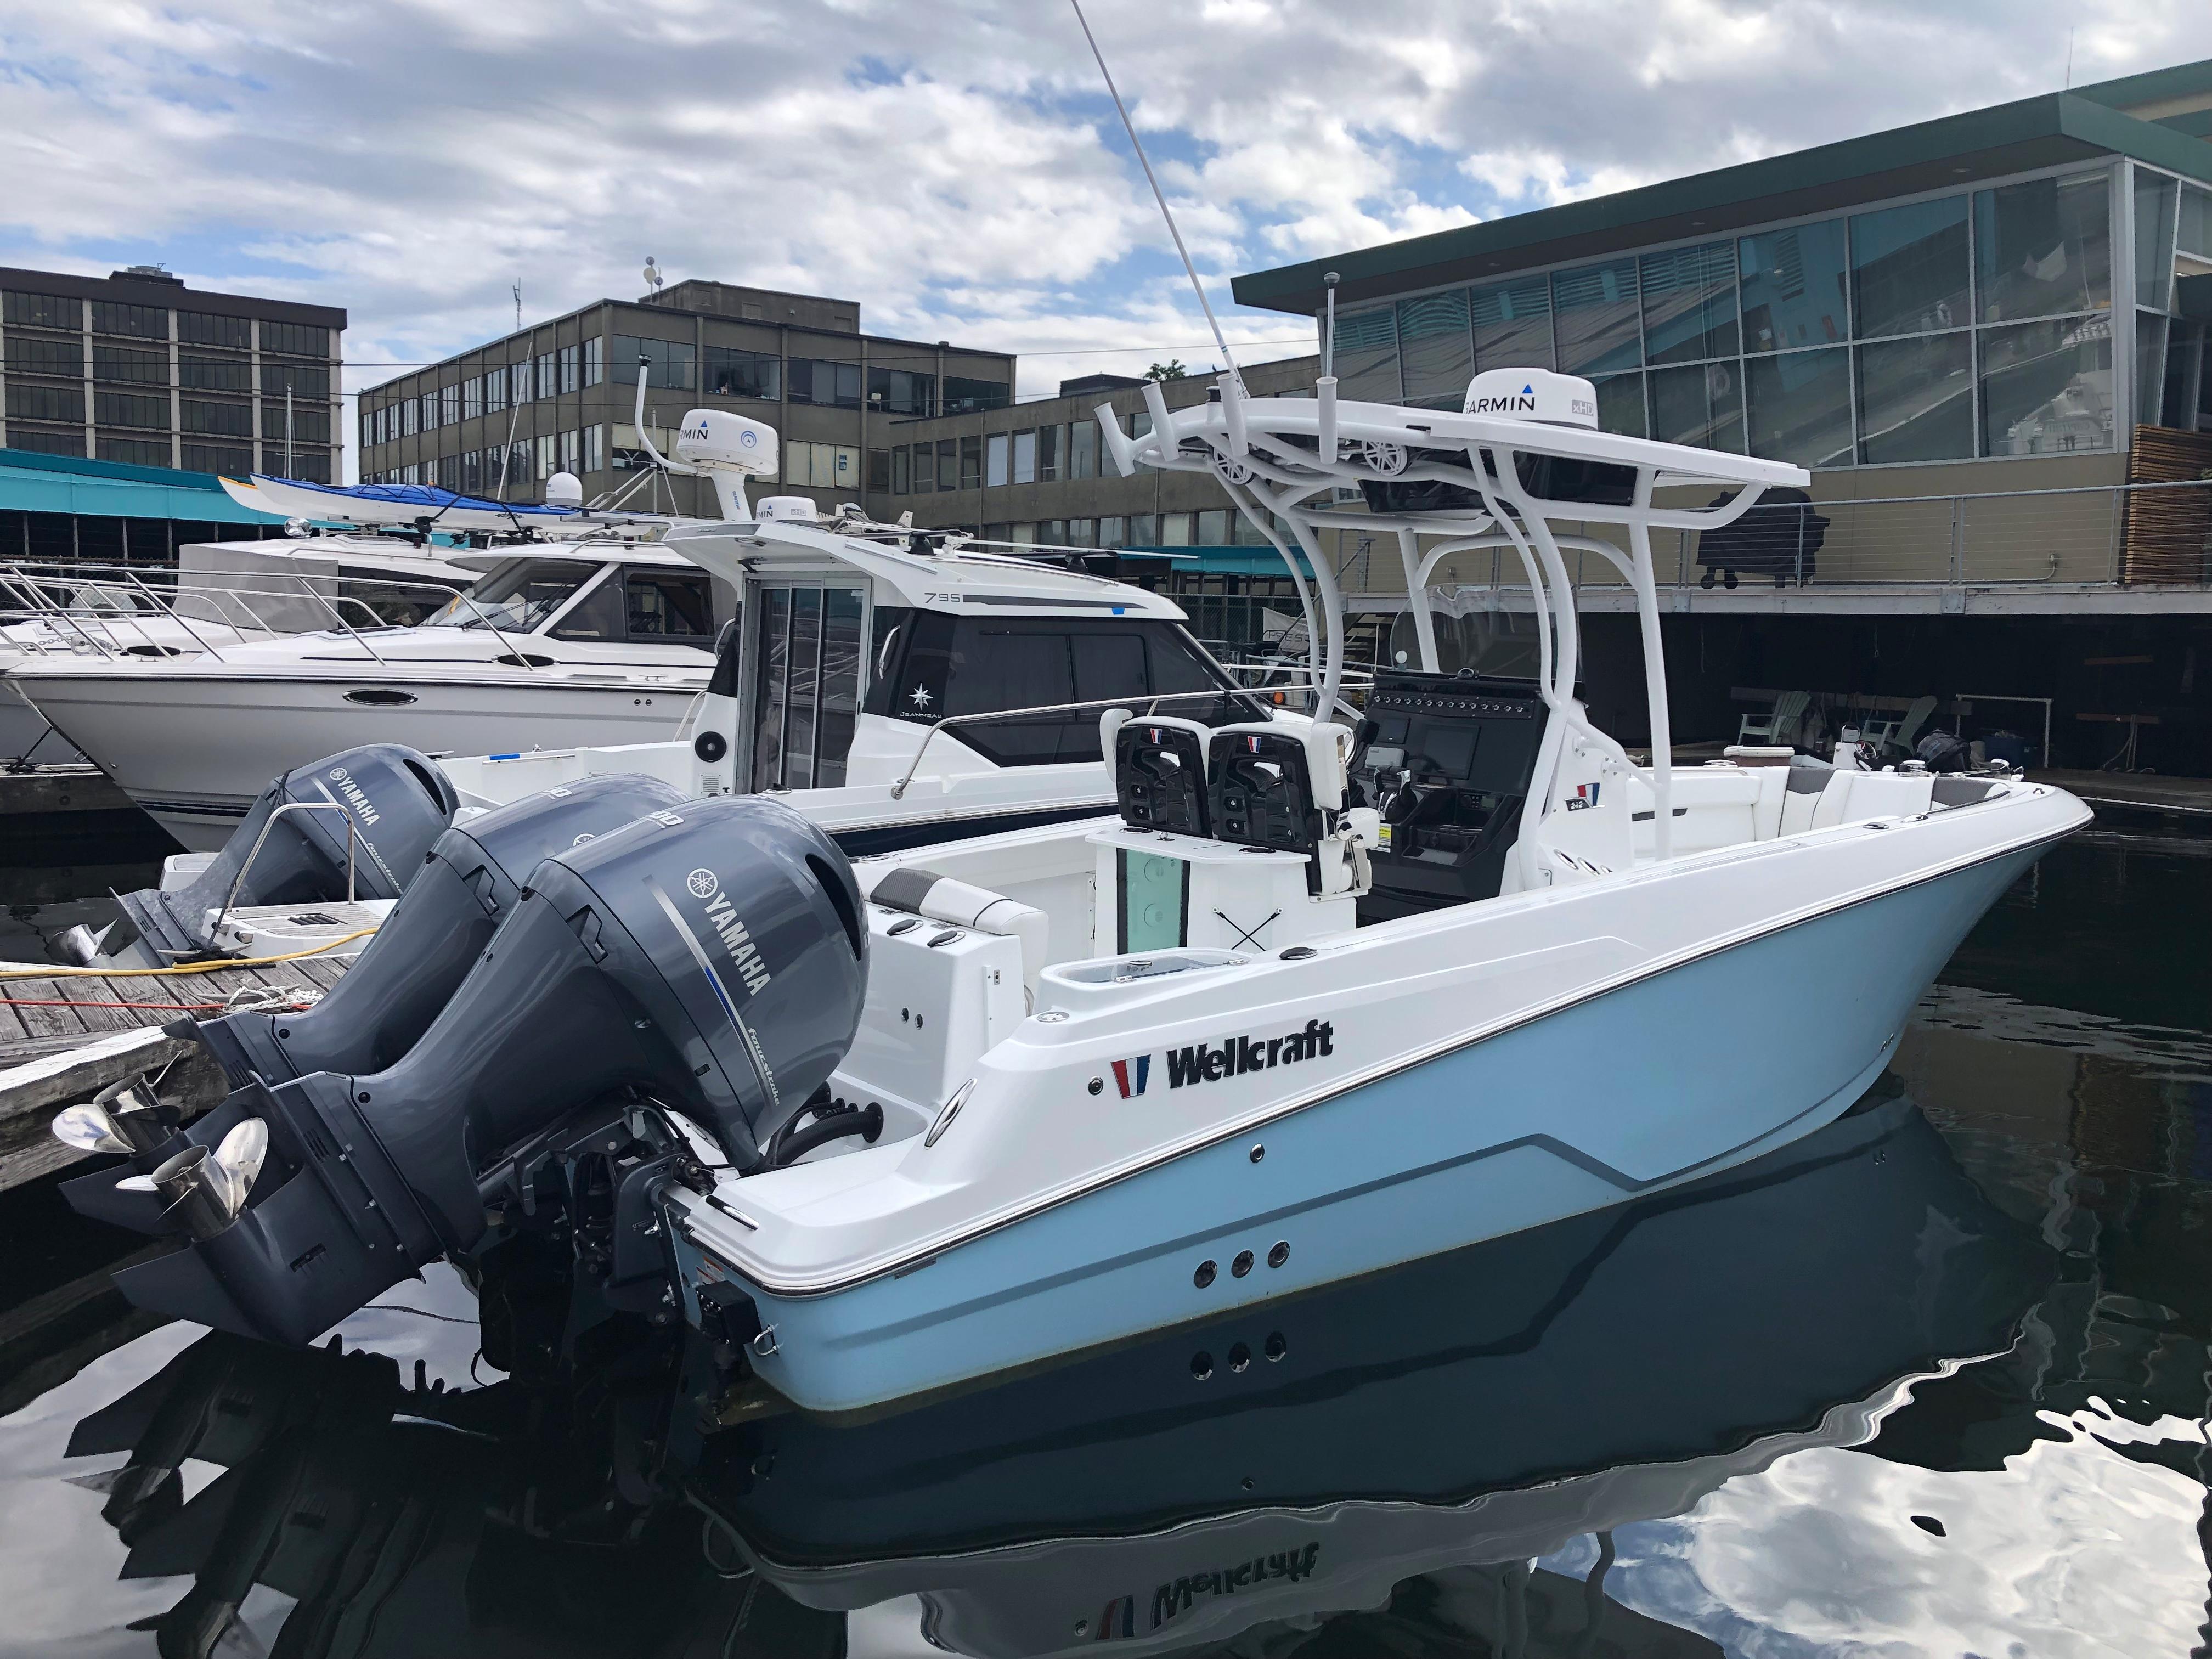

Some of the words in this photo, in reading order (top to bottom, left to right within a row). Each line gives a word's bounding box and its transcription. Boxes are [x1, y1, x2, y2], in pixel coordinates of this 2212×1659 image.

[1573, 400, 1593, 415] xHD
[680, 428, 708, 440] RMIN
[924, 592, 960, 603] 795
[338, 776, 380, 826] YAMAHA
[1570, 800, 1583, 810] 242
[704, 891, 772, 996] YAMAHA
[1166, 1019, 1334, 1089] Wellcraft
